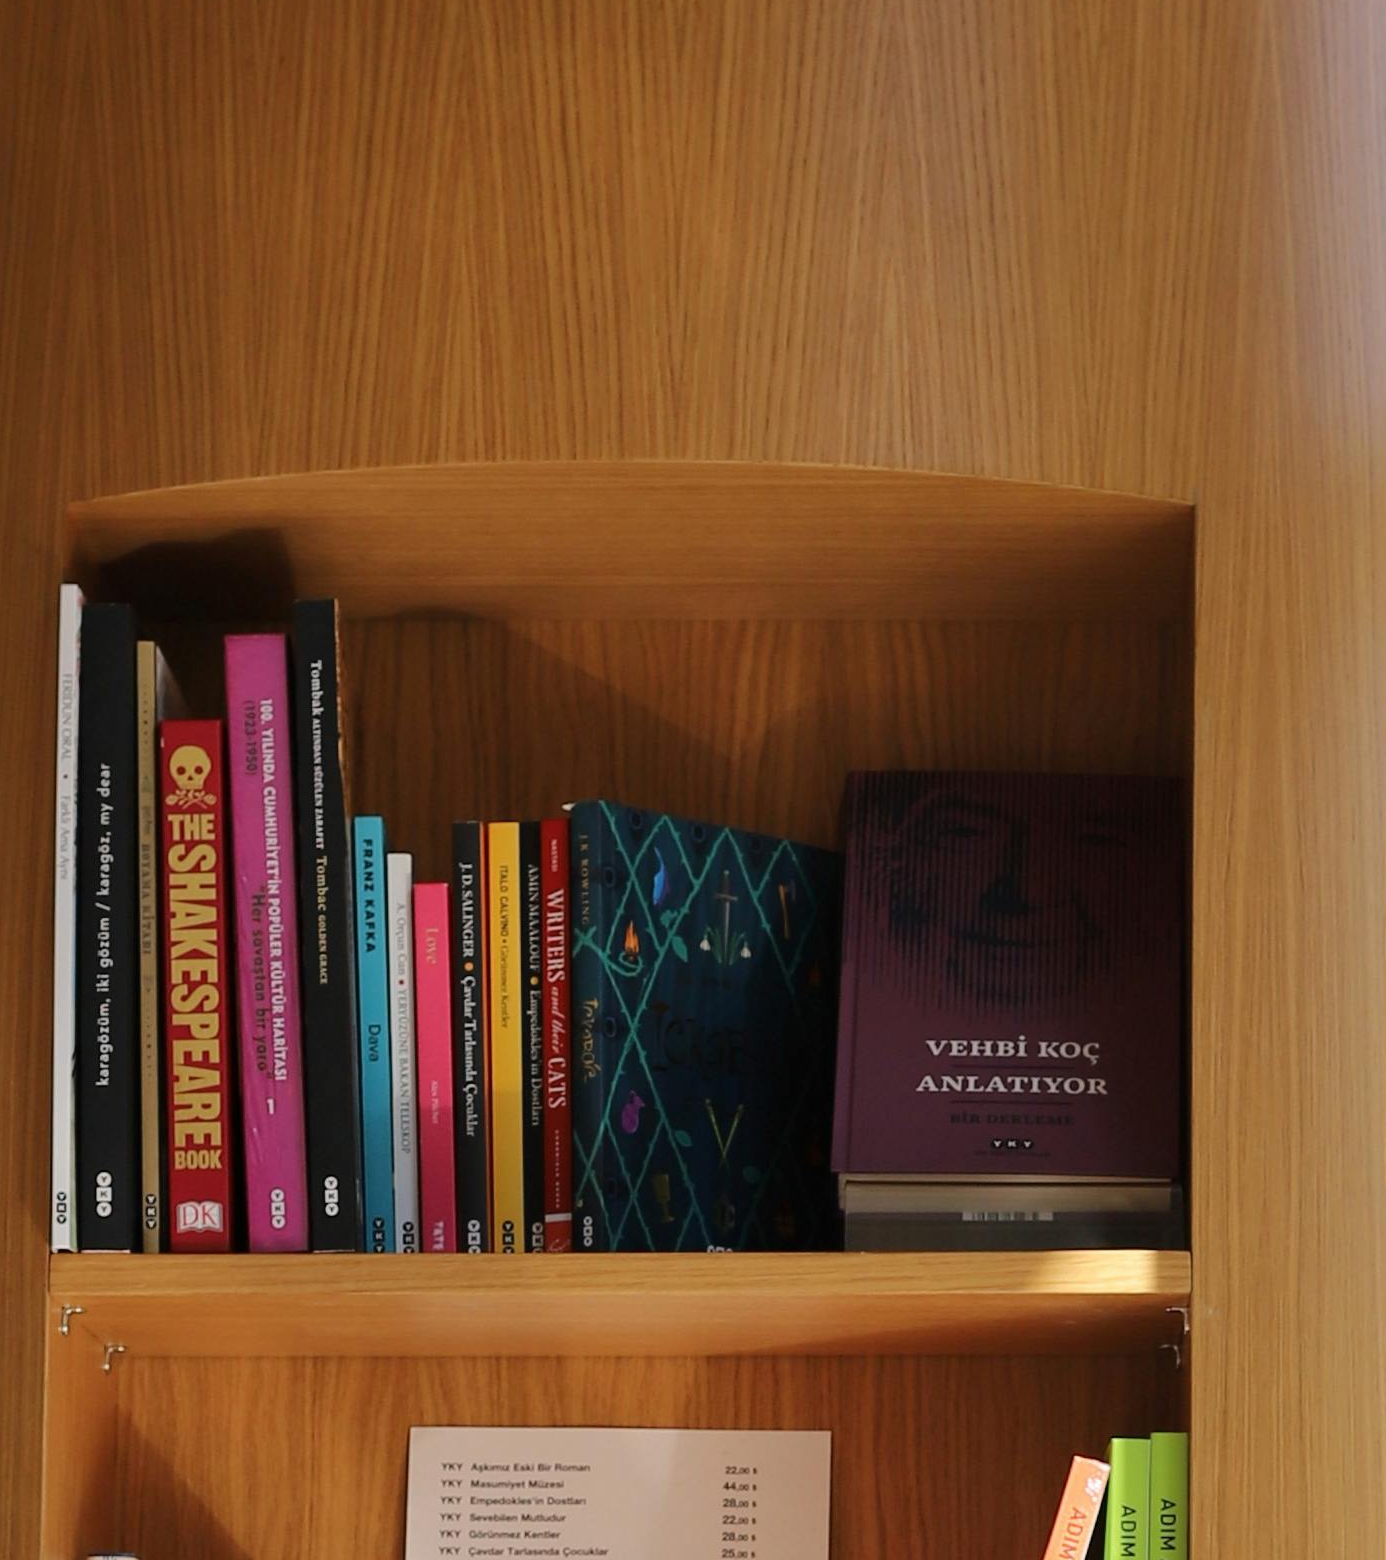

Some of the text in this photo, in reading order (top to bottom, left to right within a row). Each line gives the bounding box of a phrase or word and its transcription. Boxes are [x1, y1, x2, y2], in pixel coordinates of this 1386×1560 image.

[260, 699, 273, 725] 100.
[96, 763, 111, 798] dear
[261, 728, 275, 783] YILINDA
[100, 804, 114, 825] my
[310, 659, 328, 984] Tombak ALTINDAN SÜZÜLEN ZARAFET Tombac GOLDEN GRACE
[461, 890, 474, 957] SALINGER
[499, 865, 509, 937] ITALO CALVINO
[97, 917, 114, 968] gözüm
[268, 899, 284, 957] POPÜLER
[362, 838, 381, 1062] FRANZ KAFKA Dava
[426, 927, 438, 965] Love
[529, 904, 540, 972] MAALOUF
[547, 889, 565, 983] WRITERS
[96, 973, 110, 991] iki
[168, 814, 222, 1170] THE SHAKESPEARE BOOK
[270, 960, 286, 1012] KÜLTÜR
[460, 976, 474, 1018] Çavdar
[550, 986, 566, 1018] and
[256, 1009, 270, 1031] bir
[550, 1019, 566, 1053] their
[272, 1018, 288, 1081] HARİTASI
[924, 1034, 1100, 1065] VEHBİ KOÇ
[548, 1057, 566, 1109] CATS
[915, 1074, 1108, 1095] ANLATIYOR
[463, 1083, 478, 1137] Çocuklar
[1121, 1505, 1136, 1558] ADIM
[1160, 1497, 1176, 1551] ADIM
